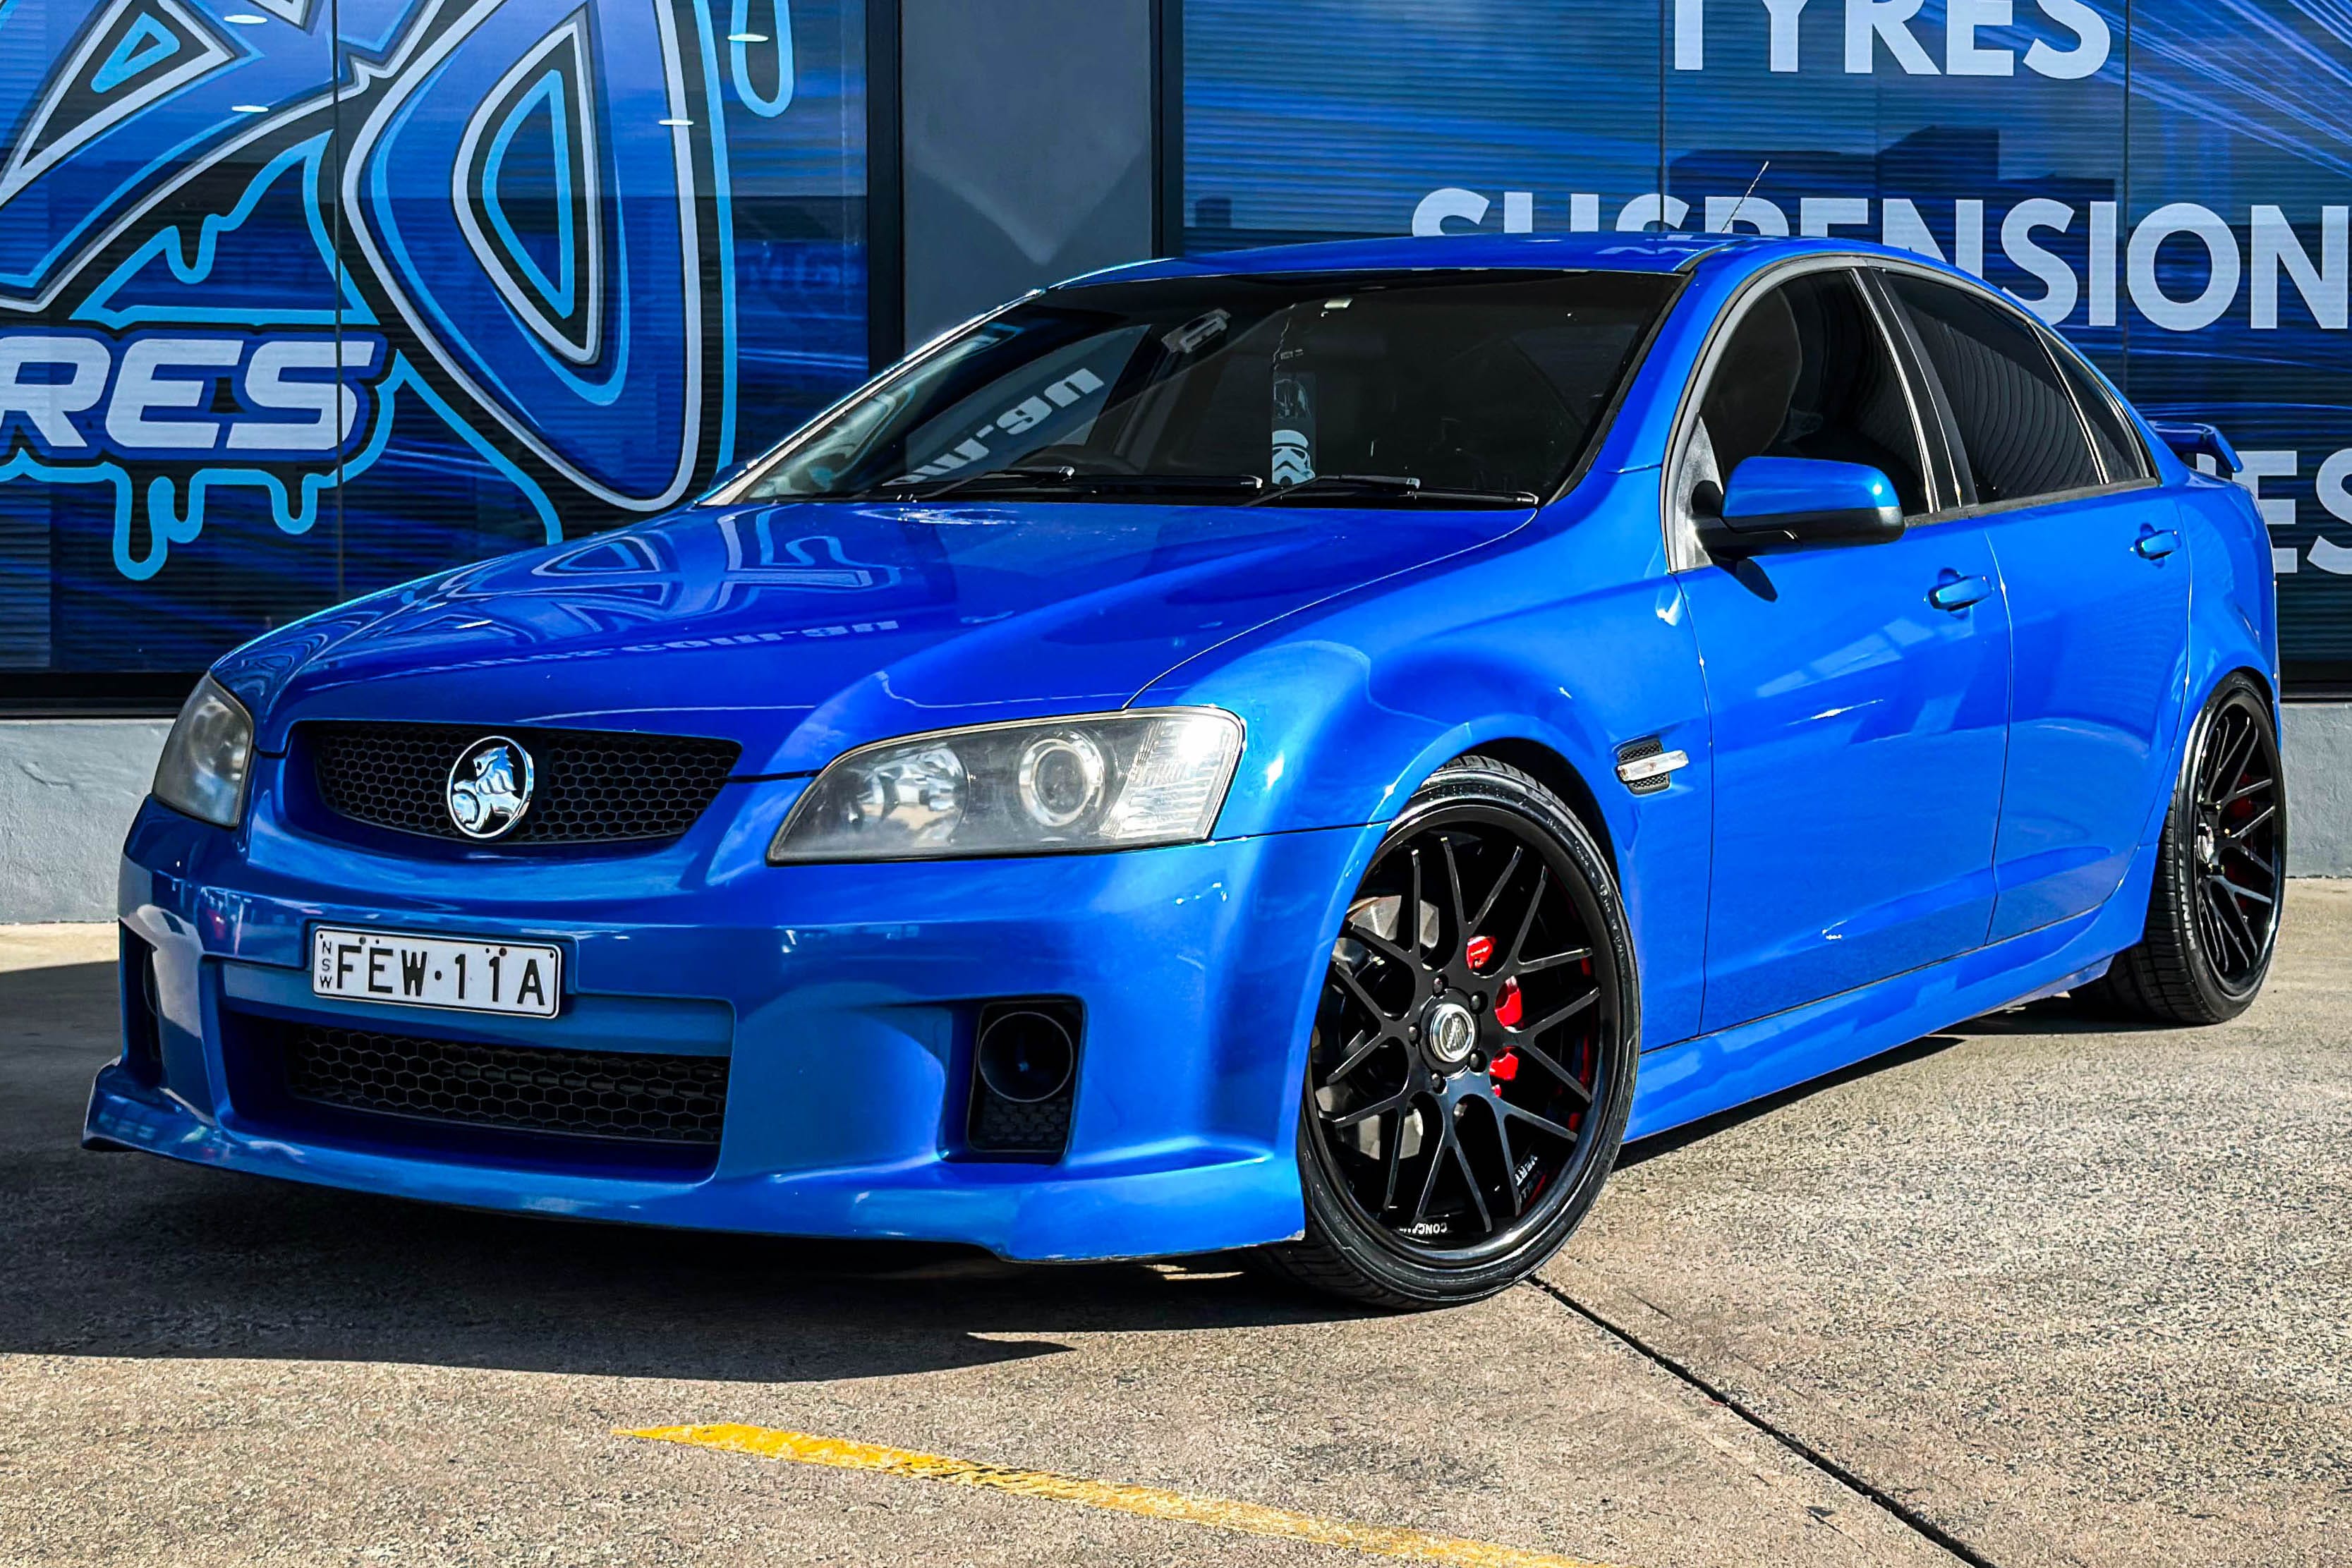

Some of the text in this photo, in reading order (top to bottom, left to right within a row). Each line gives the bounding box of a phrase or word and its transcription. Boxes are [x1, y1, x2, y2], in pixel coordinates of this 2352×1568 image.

[1412, 188, 2349, 332] NSION
[0, 336, 376, 451] RES
[2196, 448, 2352, 575] ES
